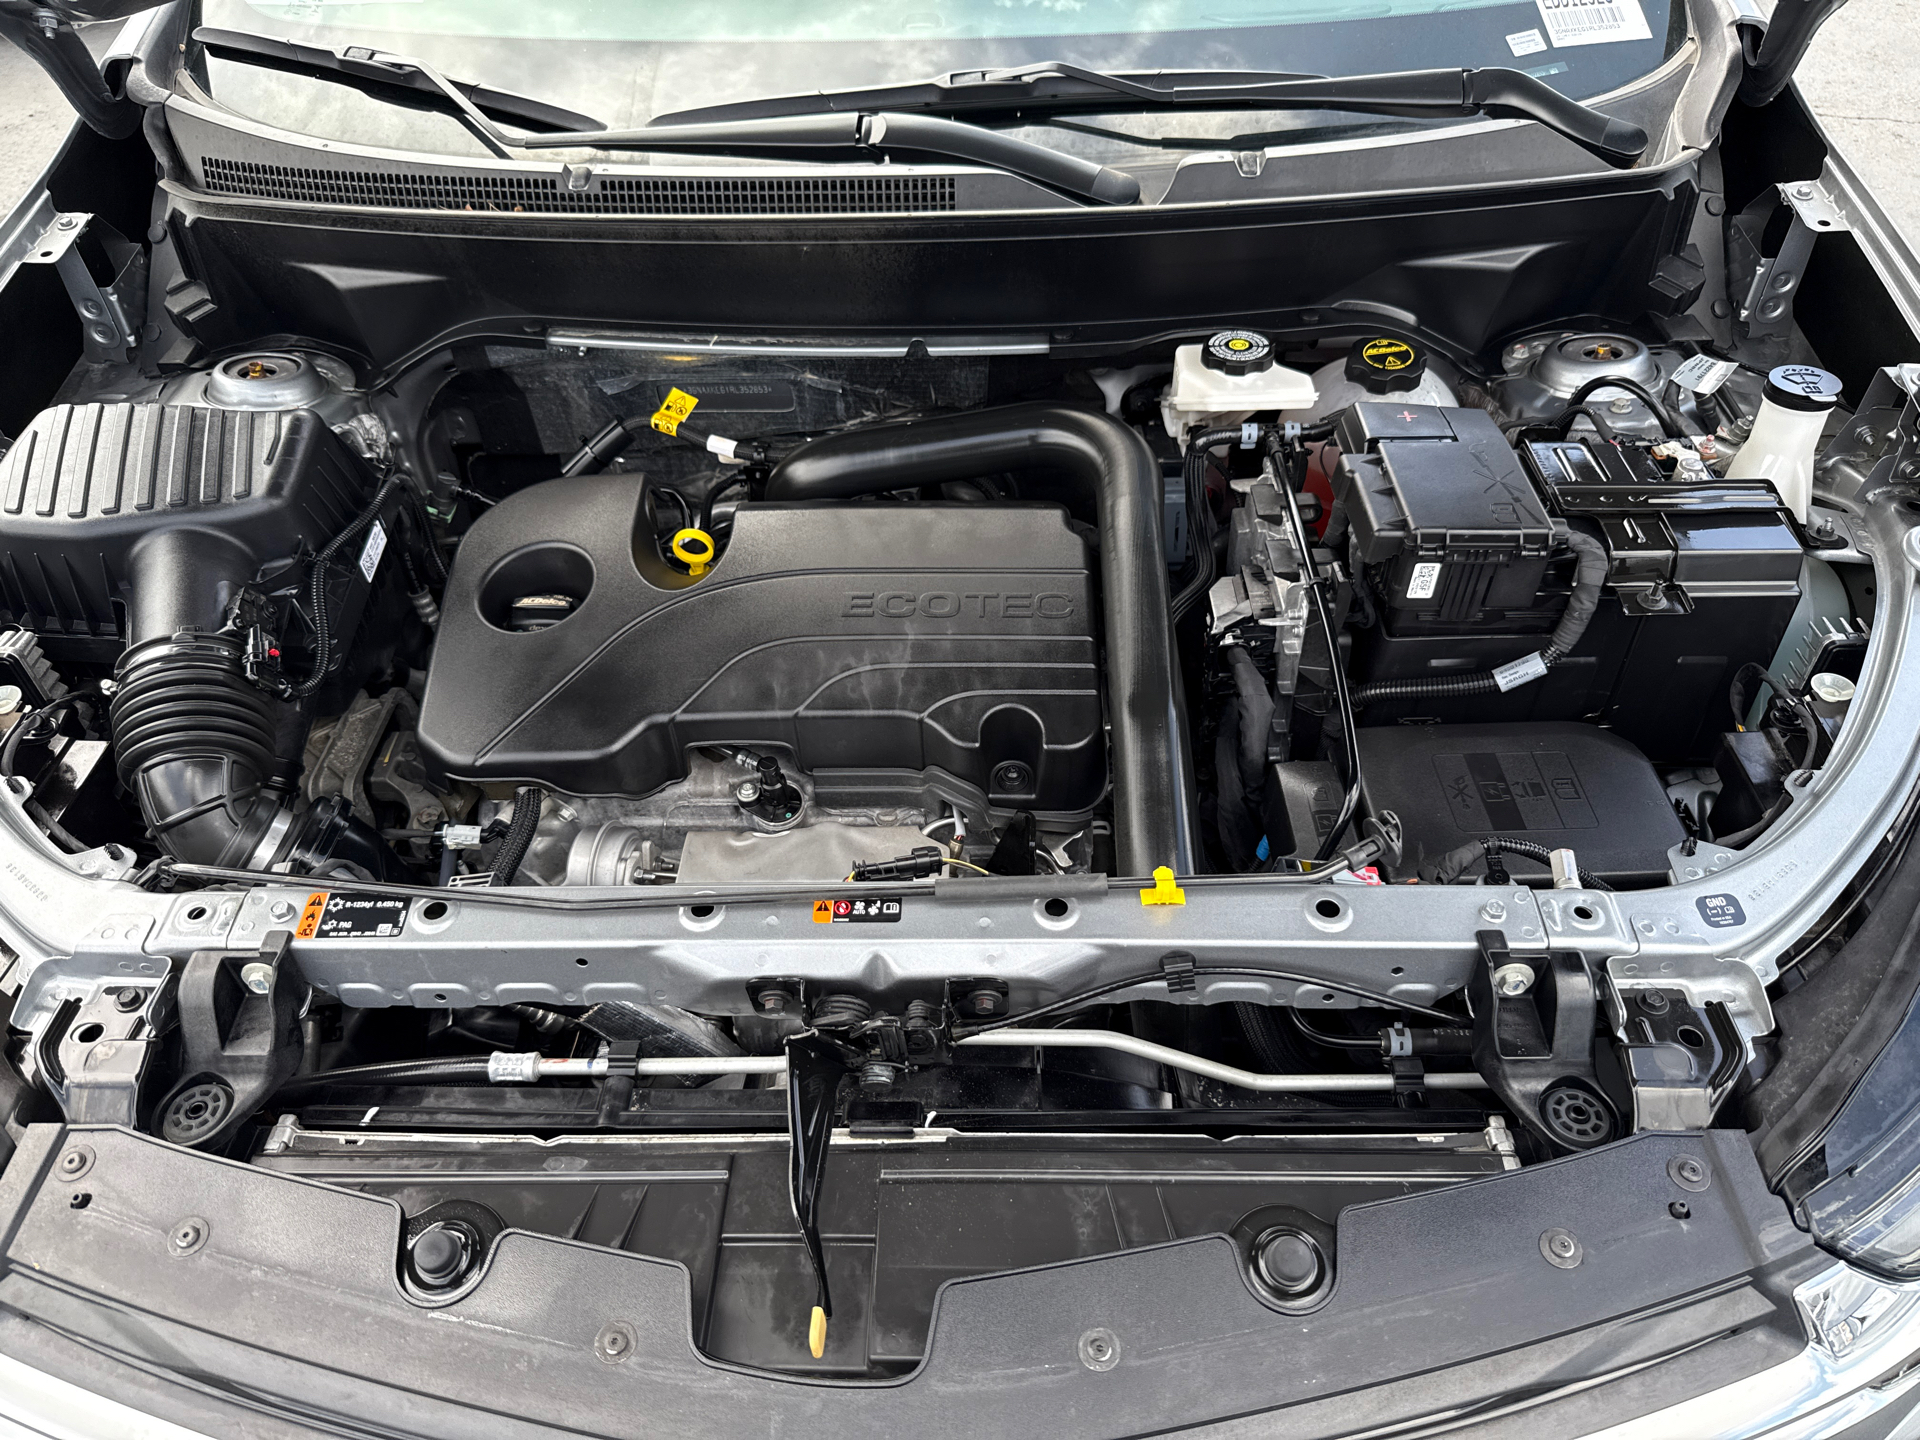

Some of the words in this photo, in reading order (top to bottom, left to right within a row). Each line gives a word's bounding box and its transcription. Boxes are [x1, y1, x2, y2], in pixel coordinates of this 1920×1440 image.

[519, 597, 567, 606] ACDelco
[841, 591, 1074, 619] ECOTEC
[395, 901, 404, 909] kg
[1705, 896, 1727, 907] GND
